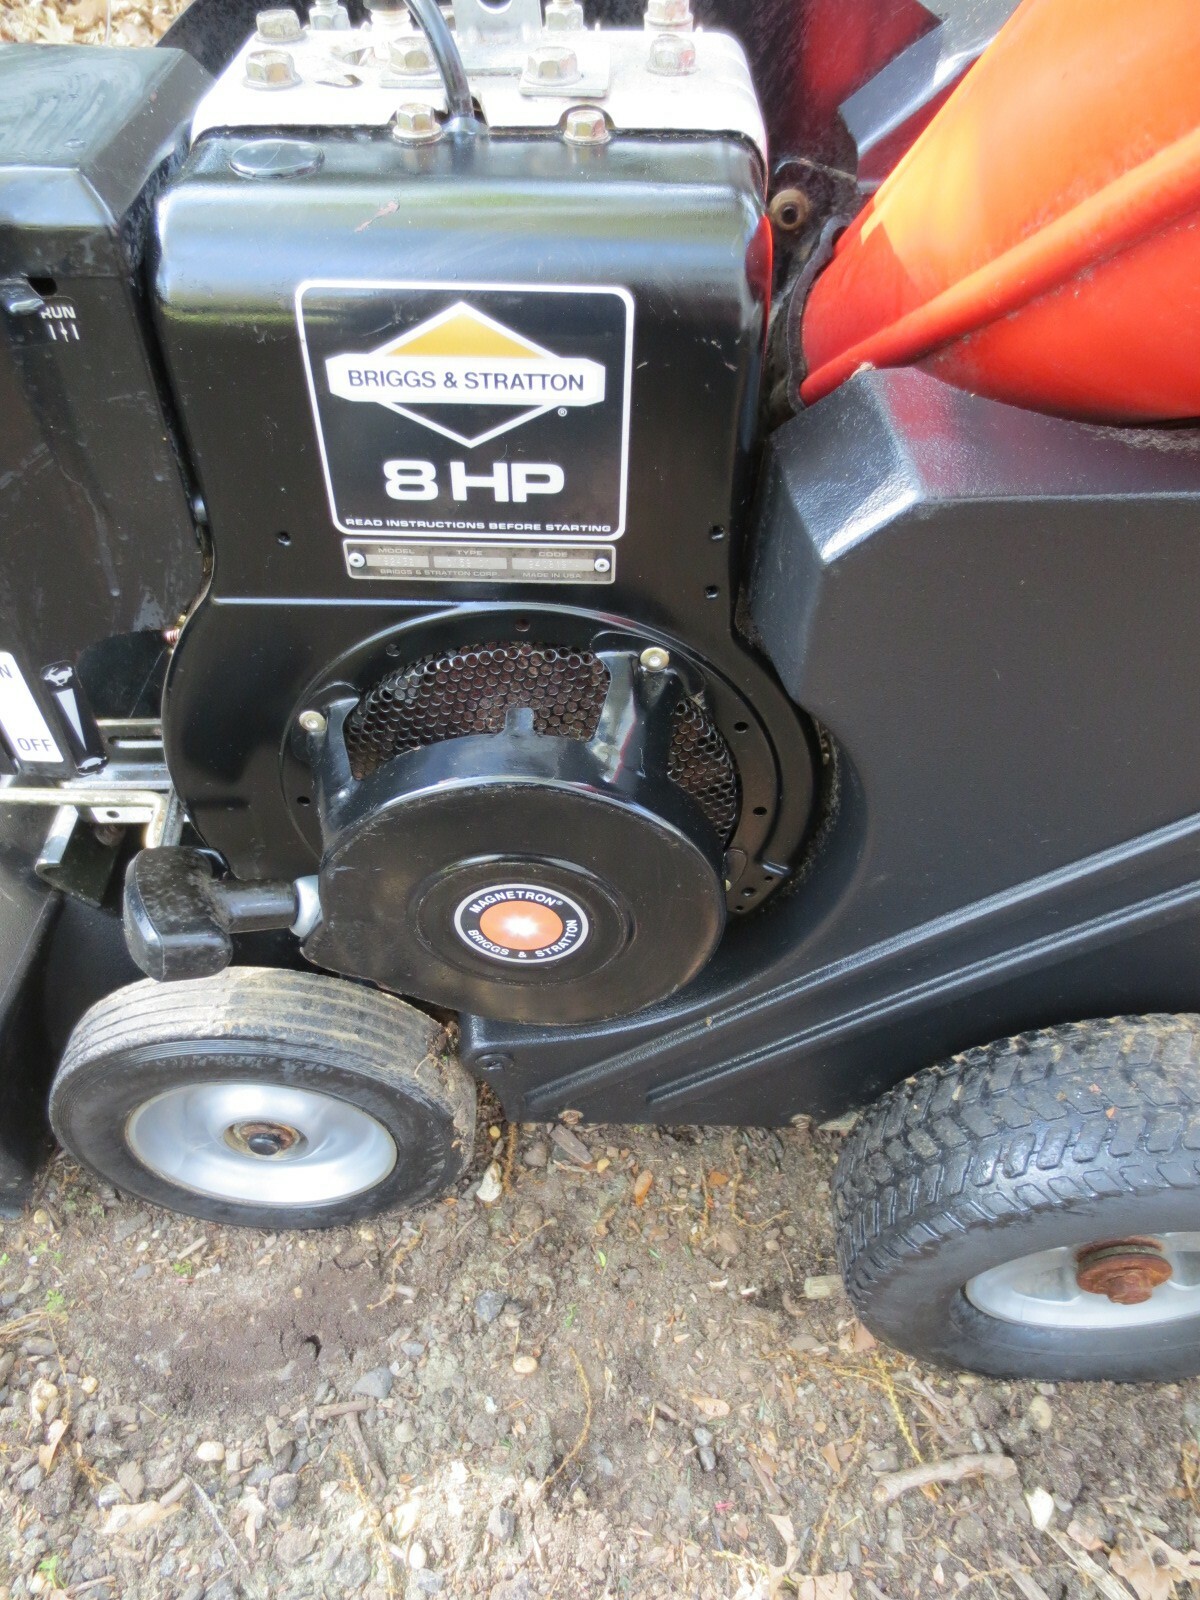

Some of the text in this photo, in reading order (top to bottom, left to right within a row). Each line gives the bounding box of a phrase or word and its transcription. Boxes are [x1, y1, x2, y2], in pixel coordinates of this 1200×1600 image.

[40, 306, 76, 319] RUN
[348, 369, 584, 391] BRIGGS & STRATTON
[383, 460, 565, 502] 8 HP
[345, 518, 611, 532] READ INSTRUCTIONS BEFORE STARTING
[424, 569, 471, 577] STRATTON
[17, 737, 51, 752] OFF
[467, 929, 510, 956] BRIGGS
[535, 919, 578, 957] STRATTON
